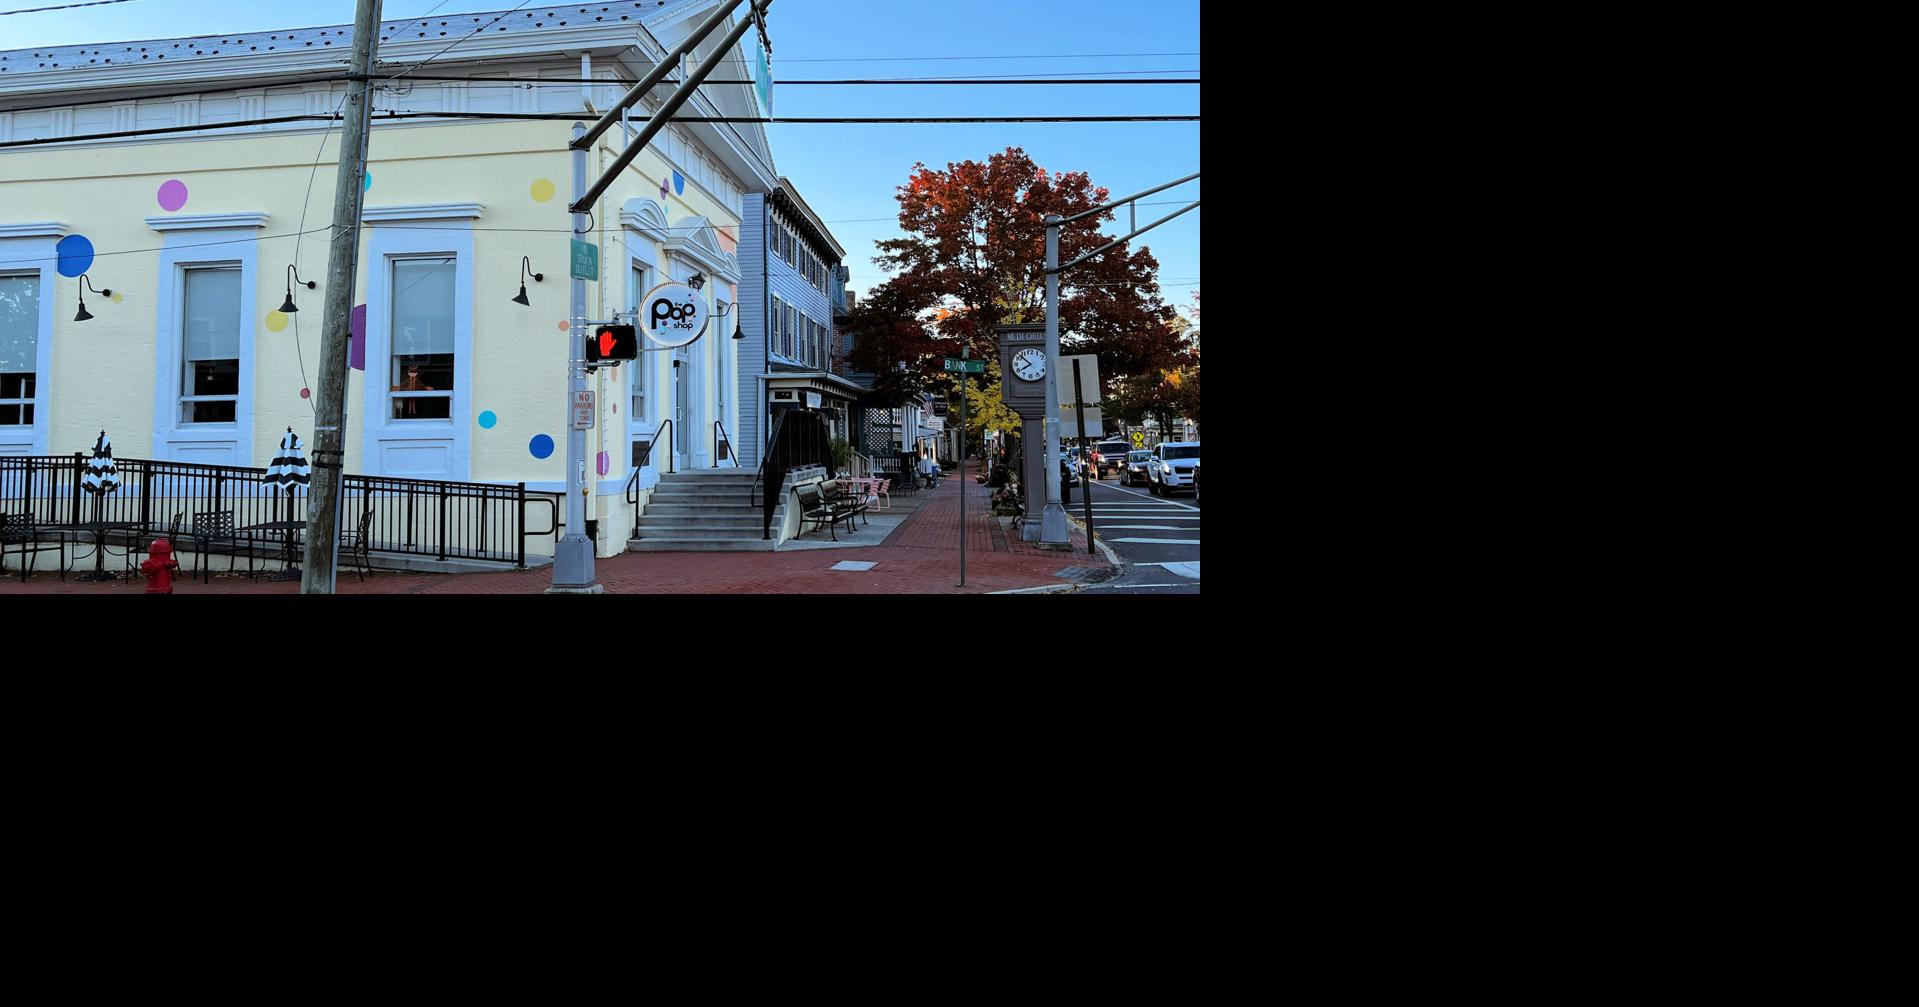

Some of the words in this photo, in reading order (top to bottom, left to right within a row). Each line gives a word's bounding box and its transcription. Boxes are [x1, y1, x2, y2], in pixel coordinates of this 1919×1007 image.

[577, 253, 593, 266] TRUCK
[575, 263, 594, 276] OUTLET
[673, 321, 693, 331] shop
[1007, 332, 1043, 341] MEDFORD
[944, 360, 967, 372] BANK
[975, 364, 985, 372] ST
[575, 402, 593, 410] PARKING
